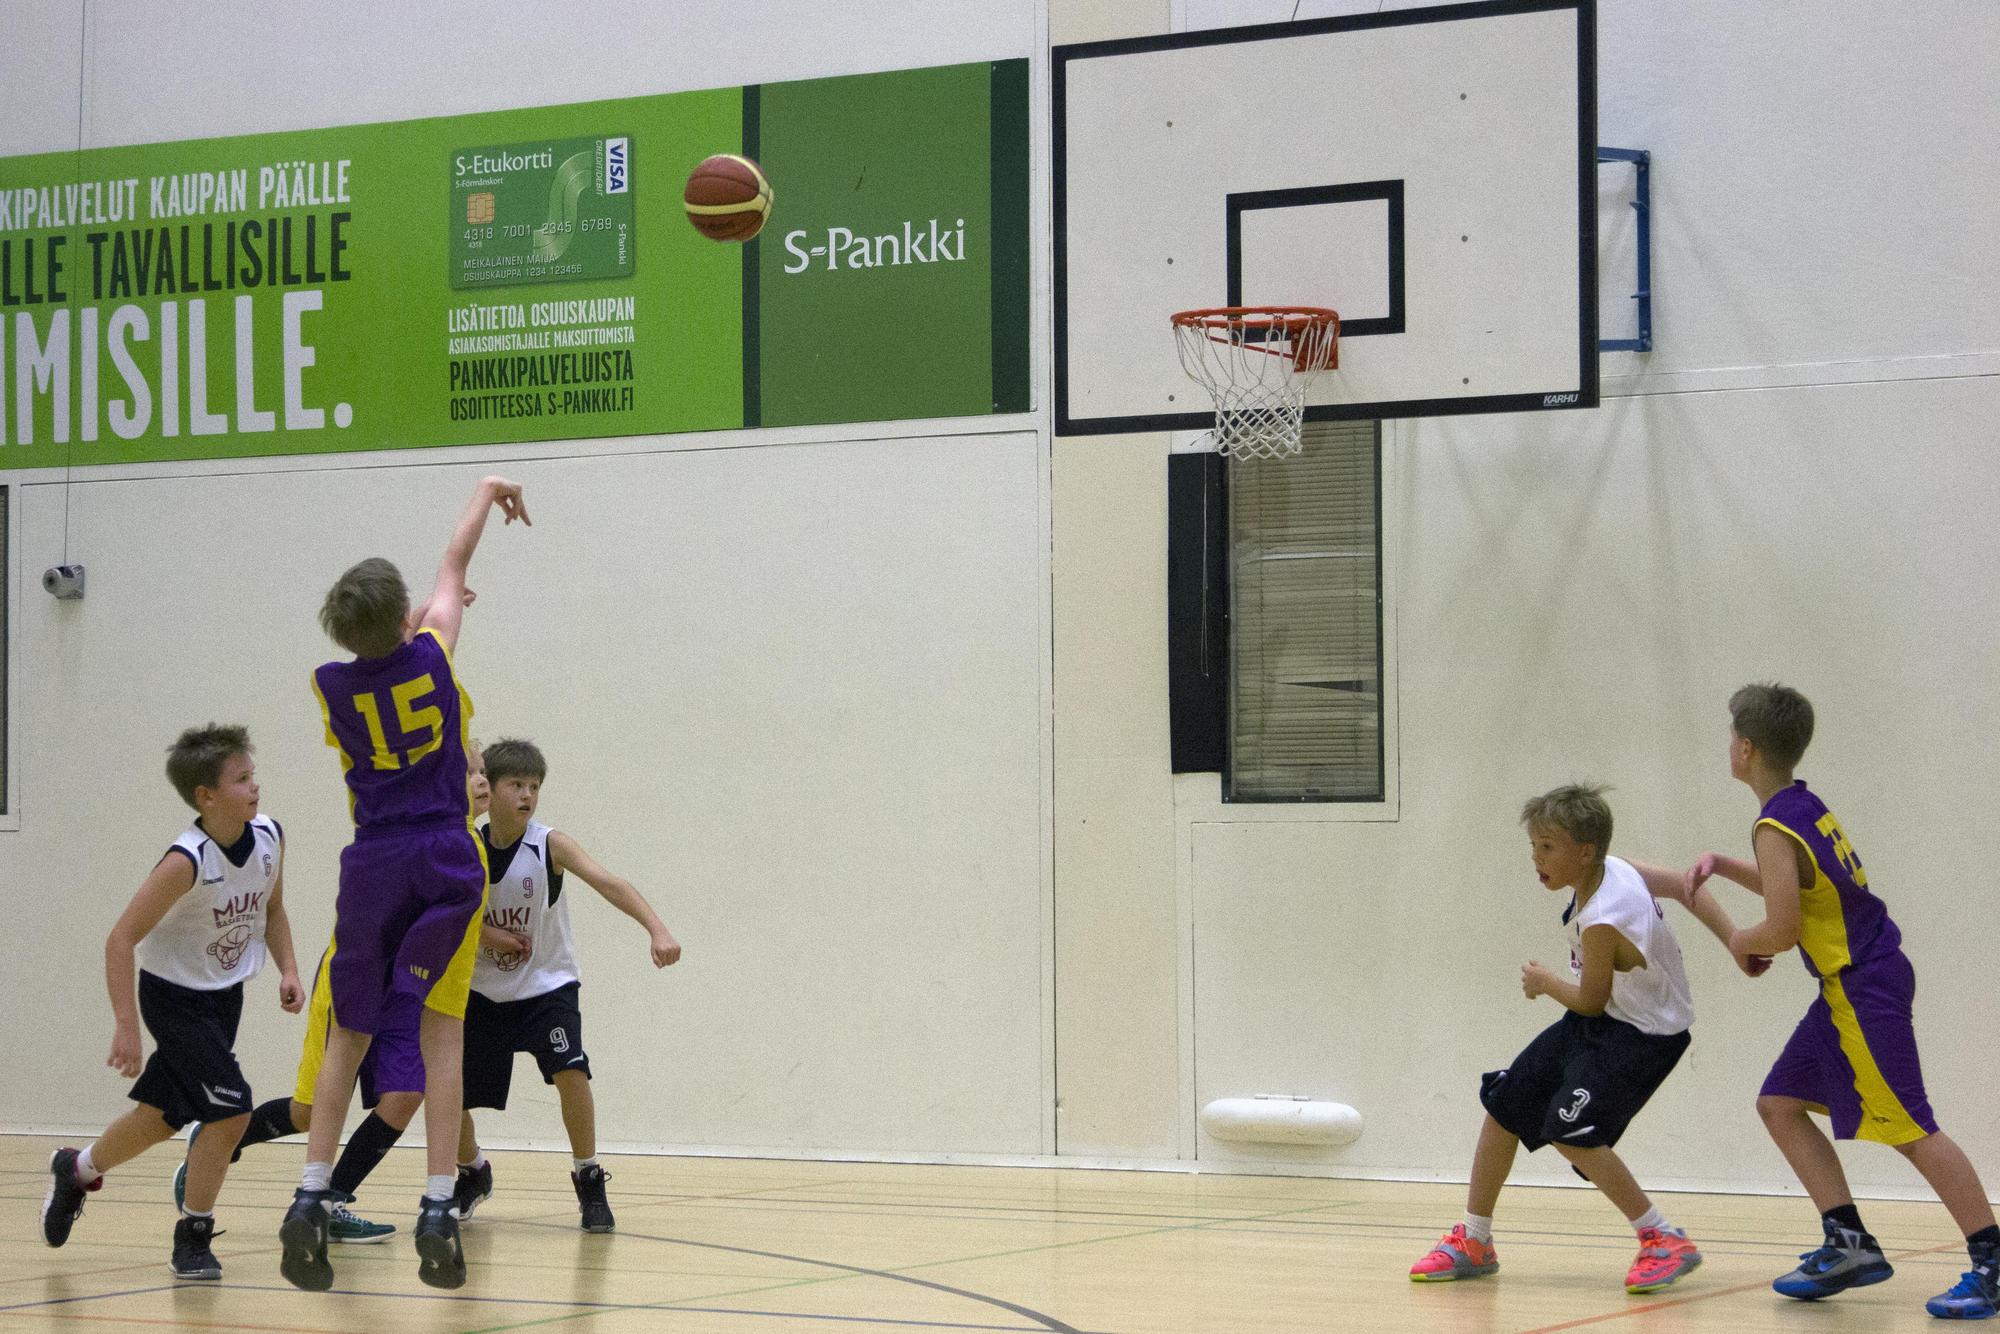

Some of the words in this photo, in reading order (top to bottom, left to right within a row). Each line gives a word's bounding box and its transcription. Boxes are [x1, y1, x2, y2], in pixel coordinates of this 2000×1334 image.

[456, 147, 552, 176] S-Etukortti
[610, 142, 624, 191] VISA
[151, 169, 247, 219] KAUPAN
[260, 160, 351, 209] PÄÄLLE
[464, 227, 493, 240] 4318
[503, 224, 531, 237] 7001
[542, 221, 572, 234] 2345
[581, 218, 612, 231] 6789
[619, 223, 627, 265] S-Pankki
[784, 218, 966, 274] S-Pankki
[87, 213, 351, 300] TAVALLISILLE
[464, 269, 522, 281] OSUUSKAUPPA
[526, 267, 546, 277] 1234
[551, 264, 582, 275] 123456
[449, 303, 525, 333] LISÄTIETOA
[531, 296, 635, 327] OSUUSKAUPAN
[449, 332, 550, 354] ASIAKASOMISTAJALLE
[554, 326, 635, 348] MAKSUTTOMISTA
[450, 349, 634, 391] PANKKIPALVELUISTA
[450, 393, 543, 421] OSOITTEESSA
[548, 387, 634, 415] S-PANKKI.FI
[1543, 394, 1579, 404] KARHU
[352, 672, 444, 770] 15
[522, 877, 533, 899] 9
[549, 1026, 569, 1053] 9
[1558, 1088, 1591, 1122] 3
